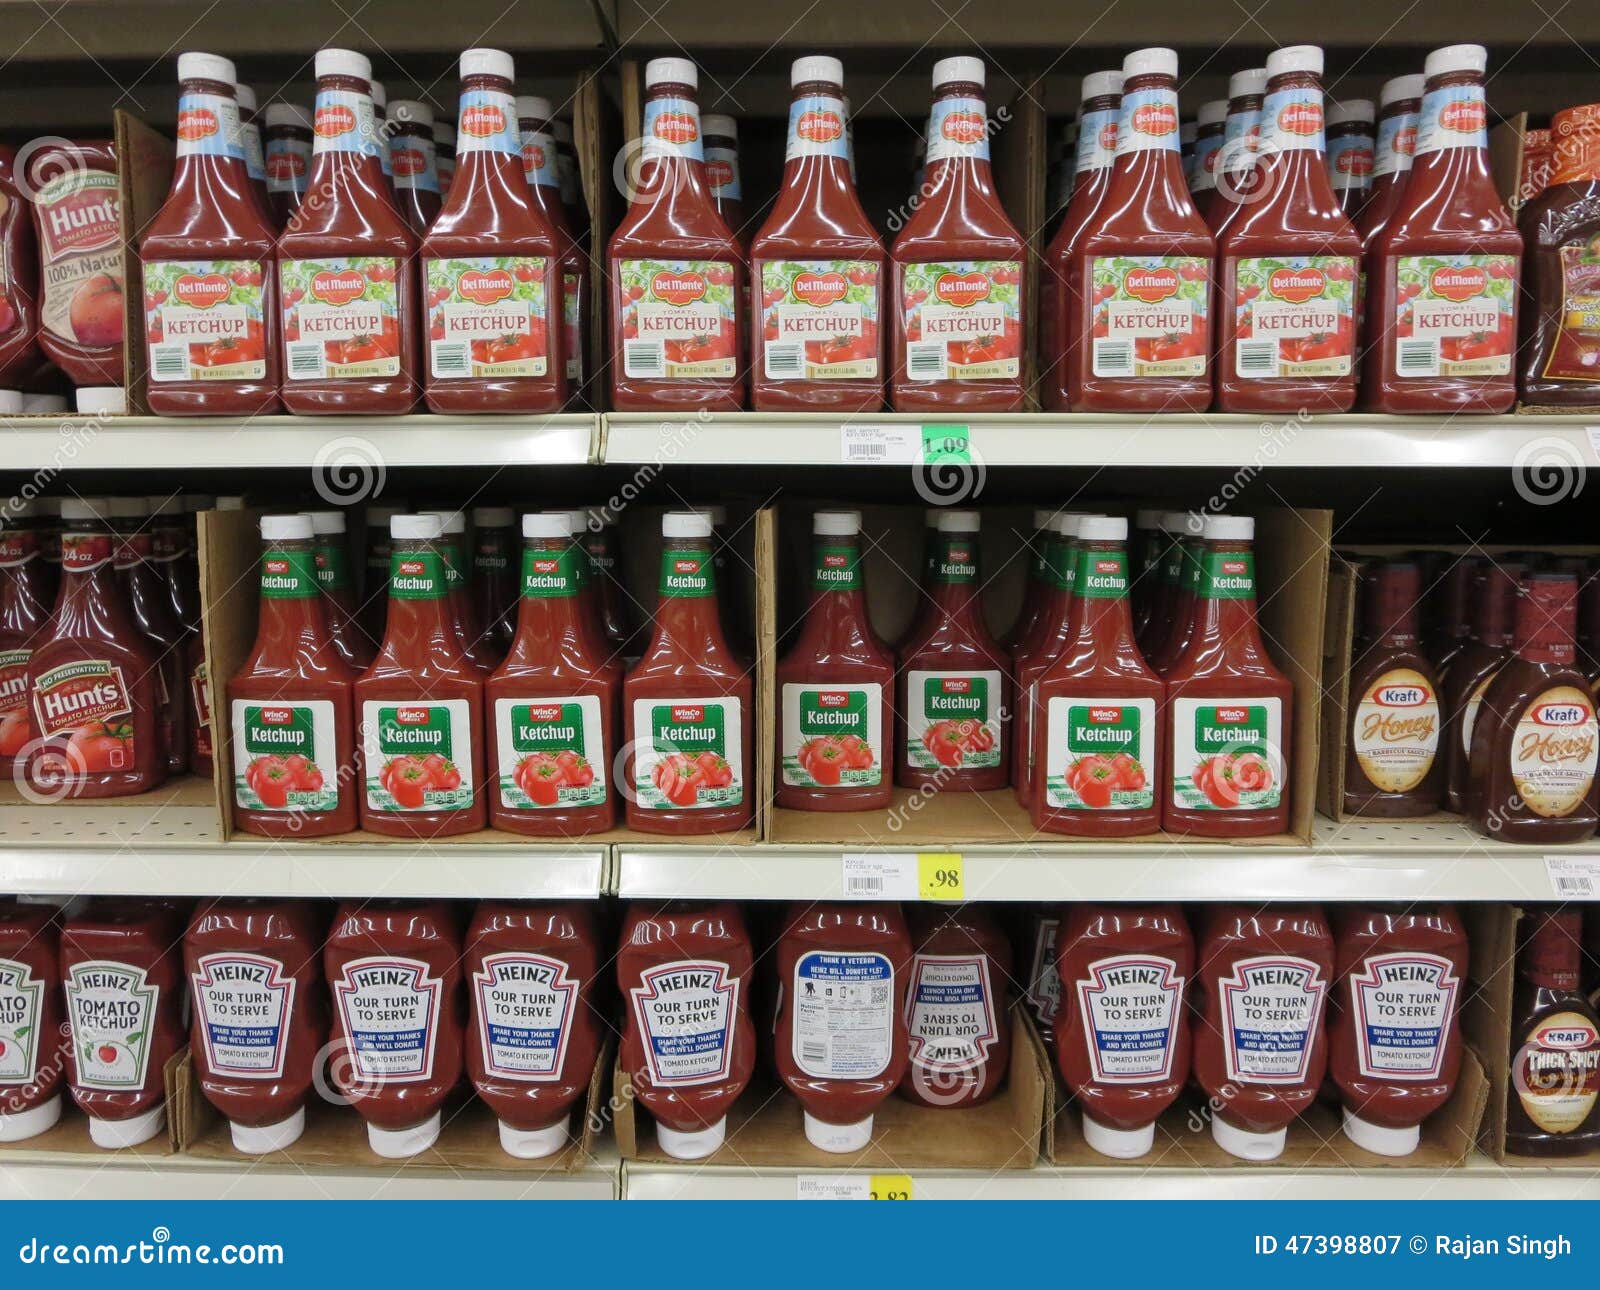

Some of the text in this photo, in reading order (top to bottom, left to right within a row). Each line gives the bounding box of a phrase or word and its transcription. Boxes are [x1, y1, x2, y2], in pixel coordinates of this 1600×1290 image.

[48, 264, 78, 284] 100%
[1434, 274, 1484, 286] Del Monte
[178, 282, 228, 294] Del Monte
[315, 279, 362, 291] Del Monte
[462, 278, 511, 290] Del Monte
[654, 280, 703, 291] Del Monte
[797, 280, 844, 292] Del Monte
[940, 281, 988, 292] Del Monte
[1128, 276, 1176, 288] Del Monte
[1273, 276, 1322, 288] Del Monte
[168, 319, 244, 334] KETCHUP
[304, 316, 378, 332] KETCHUP
[450, 315, 527, 331] KETCHUP
[643, 316, 718, 331] KETCHUP
[784, 318, 858, 332] KETCHUP
[926, 318, 1001, 332] KETCHUP
[1114, 314, 1189, 328] KETCHUP
[1258, 314, 1336, 329] KETCHUP
[1418, 312, 1496, 328] KETCHUP
[924, 437, 968, 453] 1.09
[816, 568, 854, 582] Ketchup
[941, 564, 976, 576] Ketchup
[394, 576, 433, 590] Ketchup
[526, 575, 566, 590] Ketchup
[667, 575, 706, 590] Ketchup
[1087, 576, 1126, 589] Ketchup
[1213, 577, 1252, 590] Ketchup
[54, 666, 106, 681] PRESERVATIVES
[932, 696, 980, 710] Ketchup
[1385, 690, 1418, 702] Kraft
[51, 702, 118, 728] TOMATO KETCHUP
[533, 708, 558, 716] WinCo
[808, 710, 860, 726] Ketchup
[1092, 710, 1118, 718] WinCo
[1219, 710, 1245, 718] WinCo
[1545, 708, 1578, 721] Kraft
[520, 726, 575, 742] Ketchup
[1362, 712, 1436, 742] Honey
[252, 727, 305, 746] Ketchup
[386, 728, 442, 746] Ketchup
[660, 726, 716, 743] Ketchup
[1076, 726, 1132, 744] Ketchup
[1204, 727, 1260, 744] Ketchup
[1518, 732, 1594, 762] Honey
[929, 870, 959, 888] .98
[214, 966, 264, 982] HEINZ
[358, 970, 411, 988] HEINZ
[498, 966, 550, 984] HEINZ
[1107, 969, 1160, 986] HEINZ
[1252, 970, 1304, 986] HEINZ
[1384, 966, 1438, 984] HEINZ
[82, 974, 130, 991] HEINZ
[658, 974, 712, 993] HEINZ
[209, 990, 272, 1003] OUR TURN
[354, 996, 419, 1008] OUR TURN
[492, 990, 556, 1004] OUR TURN
[1100, 994, 1166, 1007] OUR TURN
[1242, 995, 1308, 1008] OUR TURN
[1374, 992, 1440, 1004] OUR TURN
[76, 998, 140, 1016] TOMATO
[213, 1004, 269, 1016] TO SERVE
[494, 1003, 552, 1017] TO SERVE
[654, 996, 720, 1014] OUR TURN
[1378, 1004, 1436, 1016] TO SERVE
[357, 1008, 416, 1021] TO SERVE
[658, 1010, 717, 1026] TO SERVE
[924, 1014, 976, 1024] TO SERVE
[1104, 1008, 1162, 1020] TO SERVE
[1244, 1008, 1304, 1020] TO SERVE
[80, 1015, 138, 1028] KETCHUP
[492, 1027, 511, 1036] SHARE
[512, 1030, 529, 1038] YOUR
[920, 1024, 980, 1036] OUR TURN
[1548, 1032, 1586, 1042] KRAFT
[1528, 1050, 1600, 1071] THICK SPICY
